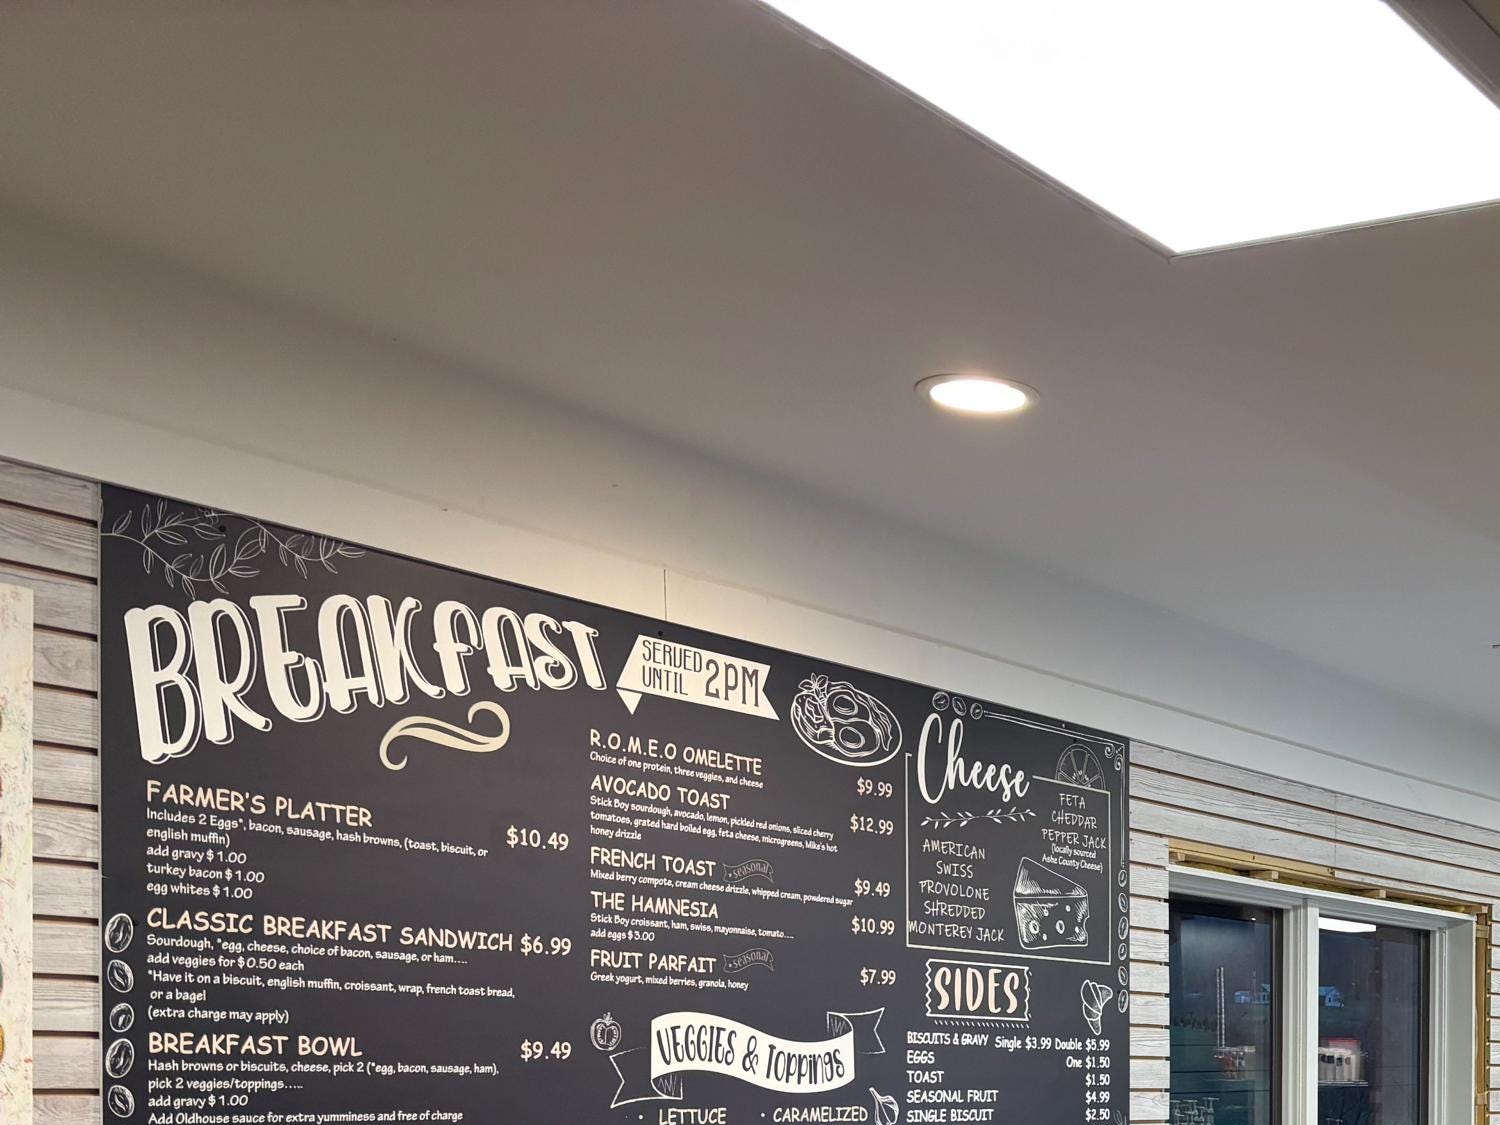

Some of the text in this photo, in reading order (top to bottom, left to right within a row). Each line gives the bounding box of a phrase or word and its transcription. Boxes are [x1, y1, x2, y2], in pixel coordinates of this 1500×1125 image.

[642, 640, 702, 673] SERVED
[123, 593, 607, 765] BREAKFAST
[642, 664, 688, 696] UNTIL
[705, 659, 759, 707] 2PM
[589, 727, 893, 798] R.O.M.E.O OMELETTE $9.99
[917, 712, 1030, 804] Cheese
[146, 778, 569, 851] FARMER'S PLATTER $10.49
[589, 773, 894, 836] AVOCADO TOAST $12.99
[921, 837, 985, 860] AMERICAN
[589, 845, 891, 898] FRENCH TOAST $9.49
[917, 878, 990, 901] PROVOLONE
[145, 906, 572, 956] CLASSIC BREAKFAST SANDWICH $6.99
[589, 889, 895, 936] THE HAMNESIA $10.99
[906, 916, 1005, 943] MONTEREY JACK
[589, 947, 896, 986] FRUIT PARFAIT $7.99
[934, 966, 1020, 1015] SIDES
[148, 1030, 572, 1061] BREAKFAST BOWL $9.49
[656, 1024, 737, 1066] VEGGIES
[742, 1035, 759, 1075] &
[906, 1029, 1111, 1053] BISCUITS & GRAVY Single $3.99 Double $5.99
[658, 1106, 727, 1125] LETTUCE
[772, 1104, 868, 1123] CARAMELIZED
[905, 1088, 1111, 1105] SEASONAL FRUIT $4.99
